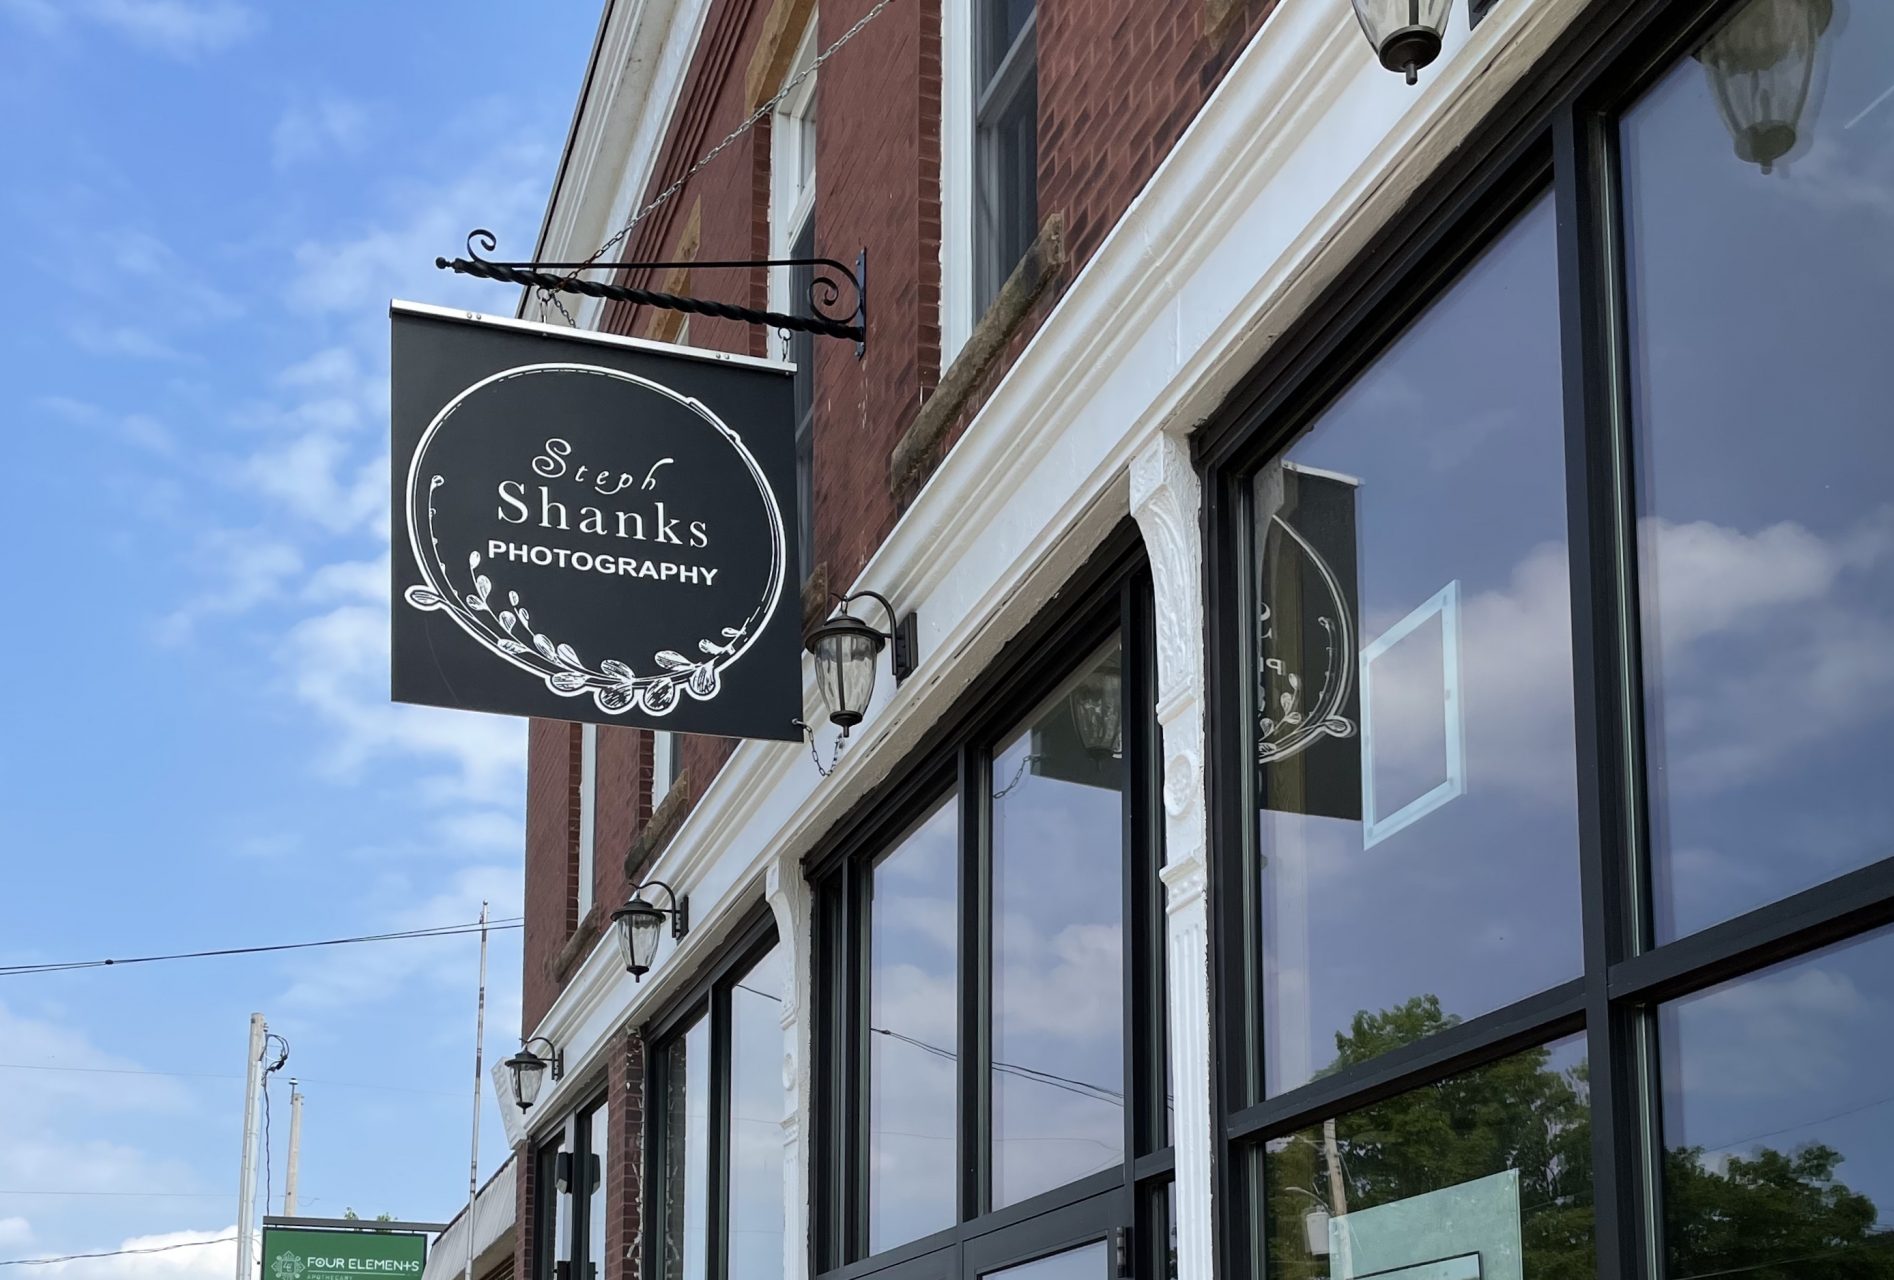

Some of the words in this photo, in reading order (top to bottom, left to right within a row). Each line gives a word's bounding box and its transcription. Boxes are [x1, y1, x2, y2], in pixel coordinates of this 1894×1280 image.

[532, 437, 674, 495] Steph
[497, 480, 709, 548] Shanks
[488, 539, 719, 586] PHOTOGRAPHY
[307, 1256, 345, 1269] FOUR
